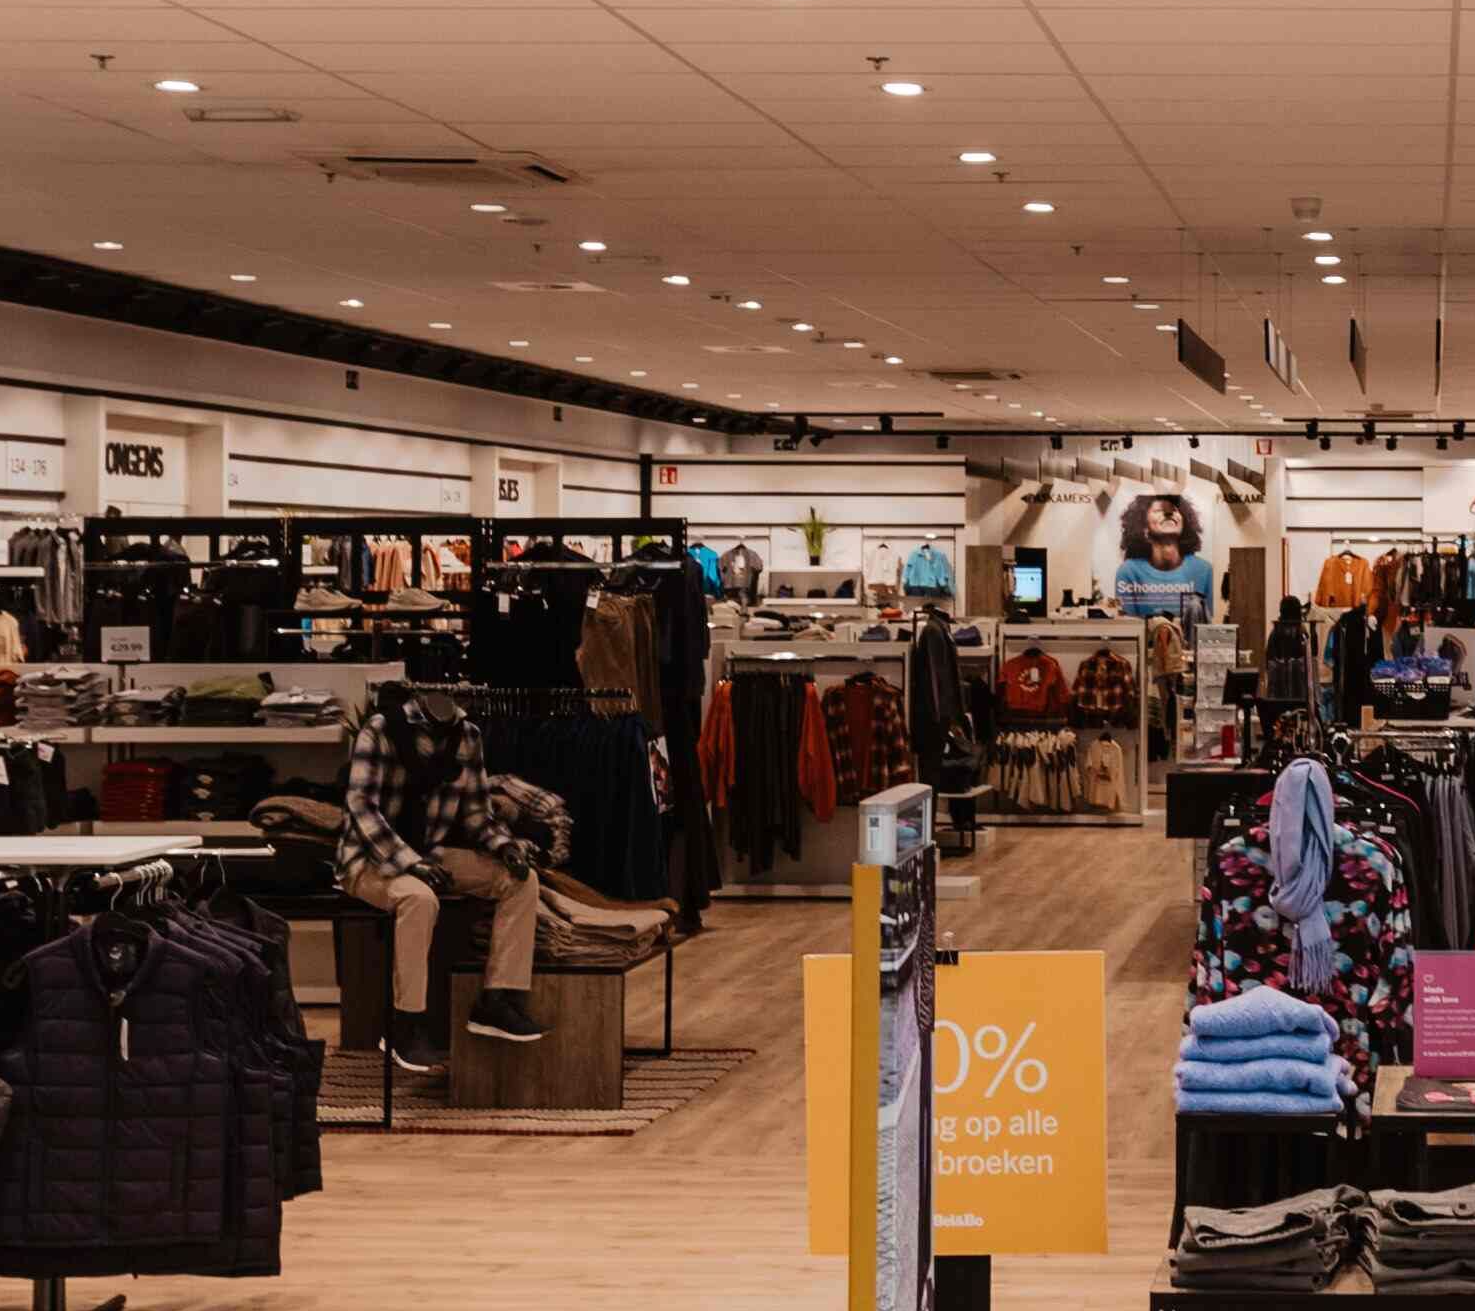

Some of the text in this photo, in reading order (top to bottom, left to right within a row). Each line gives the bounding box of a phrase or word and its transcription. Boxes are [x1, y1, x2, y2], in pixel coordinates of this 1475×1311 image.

[965, 1116, 1002, 1143] op
[1008, 1110, 1059, 1136] alle
[933, 1148, 1054, 1176] broeken
